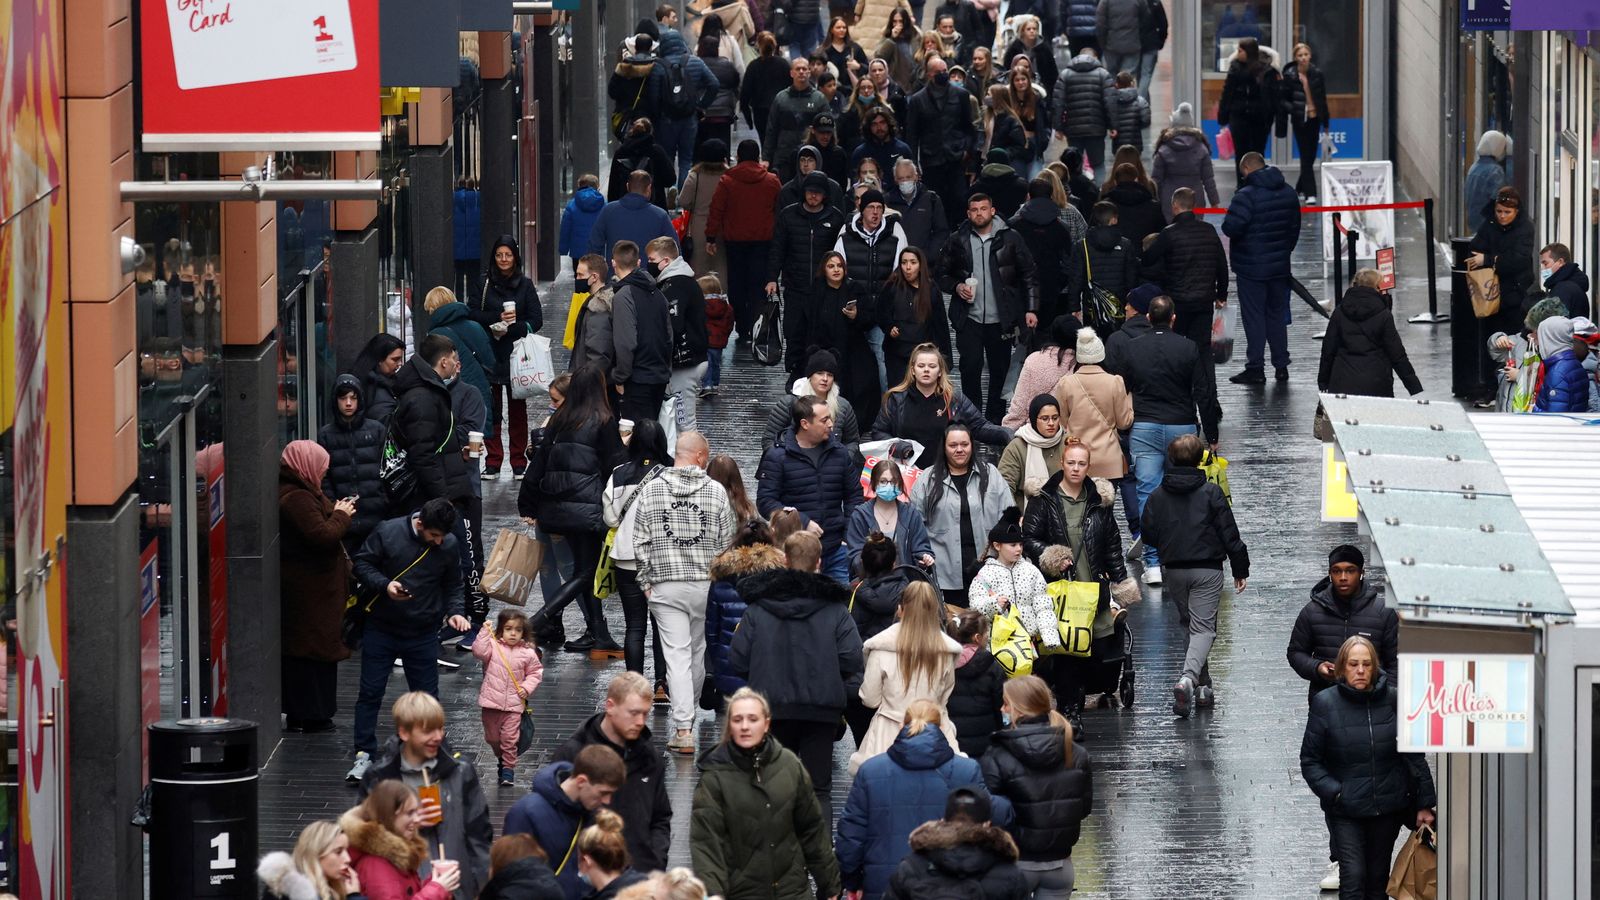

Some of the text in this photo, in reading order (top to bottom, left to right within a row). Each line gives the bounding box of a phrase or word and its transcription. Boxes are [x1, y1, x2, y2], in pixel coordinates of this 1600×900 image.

[189, 3, 233, 32] Card
[511, 371, 547, 388] next
[671, 500, 700, 513] CRAVE
[698, 509, 707, 529] THE
[486, 567, 533, 602] ZAR
[1407, 682, 1495, 721] Millie's
[210, 832, 236, 869] 1
